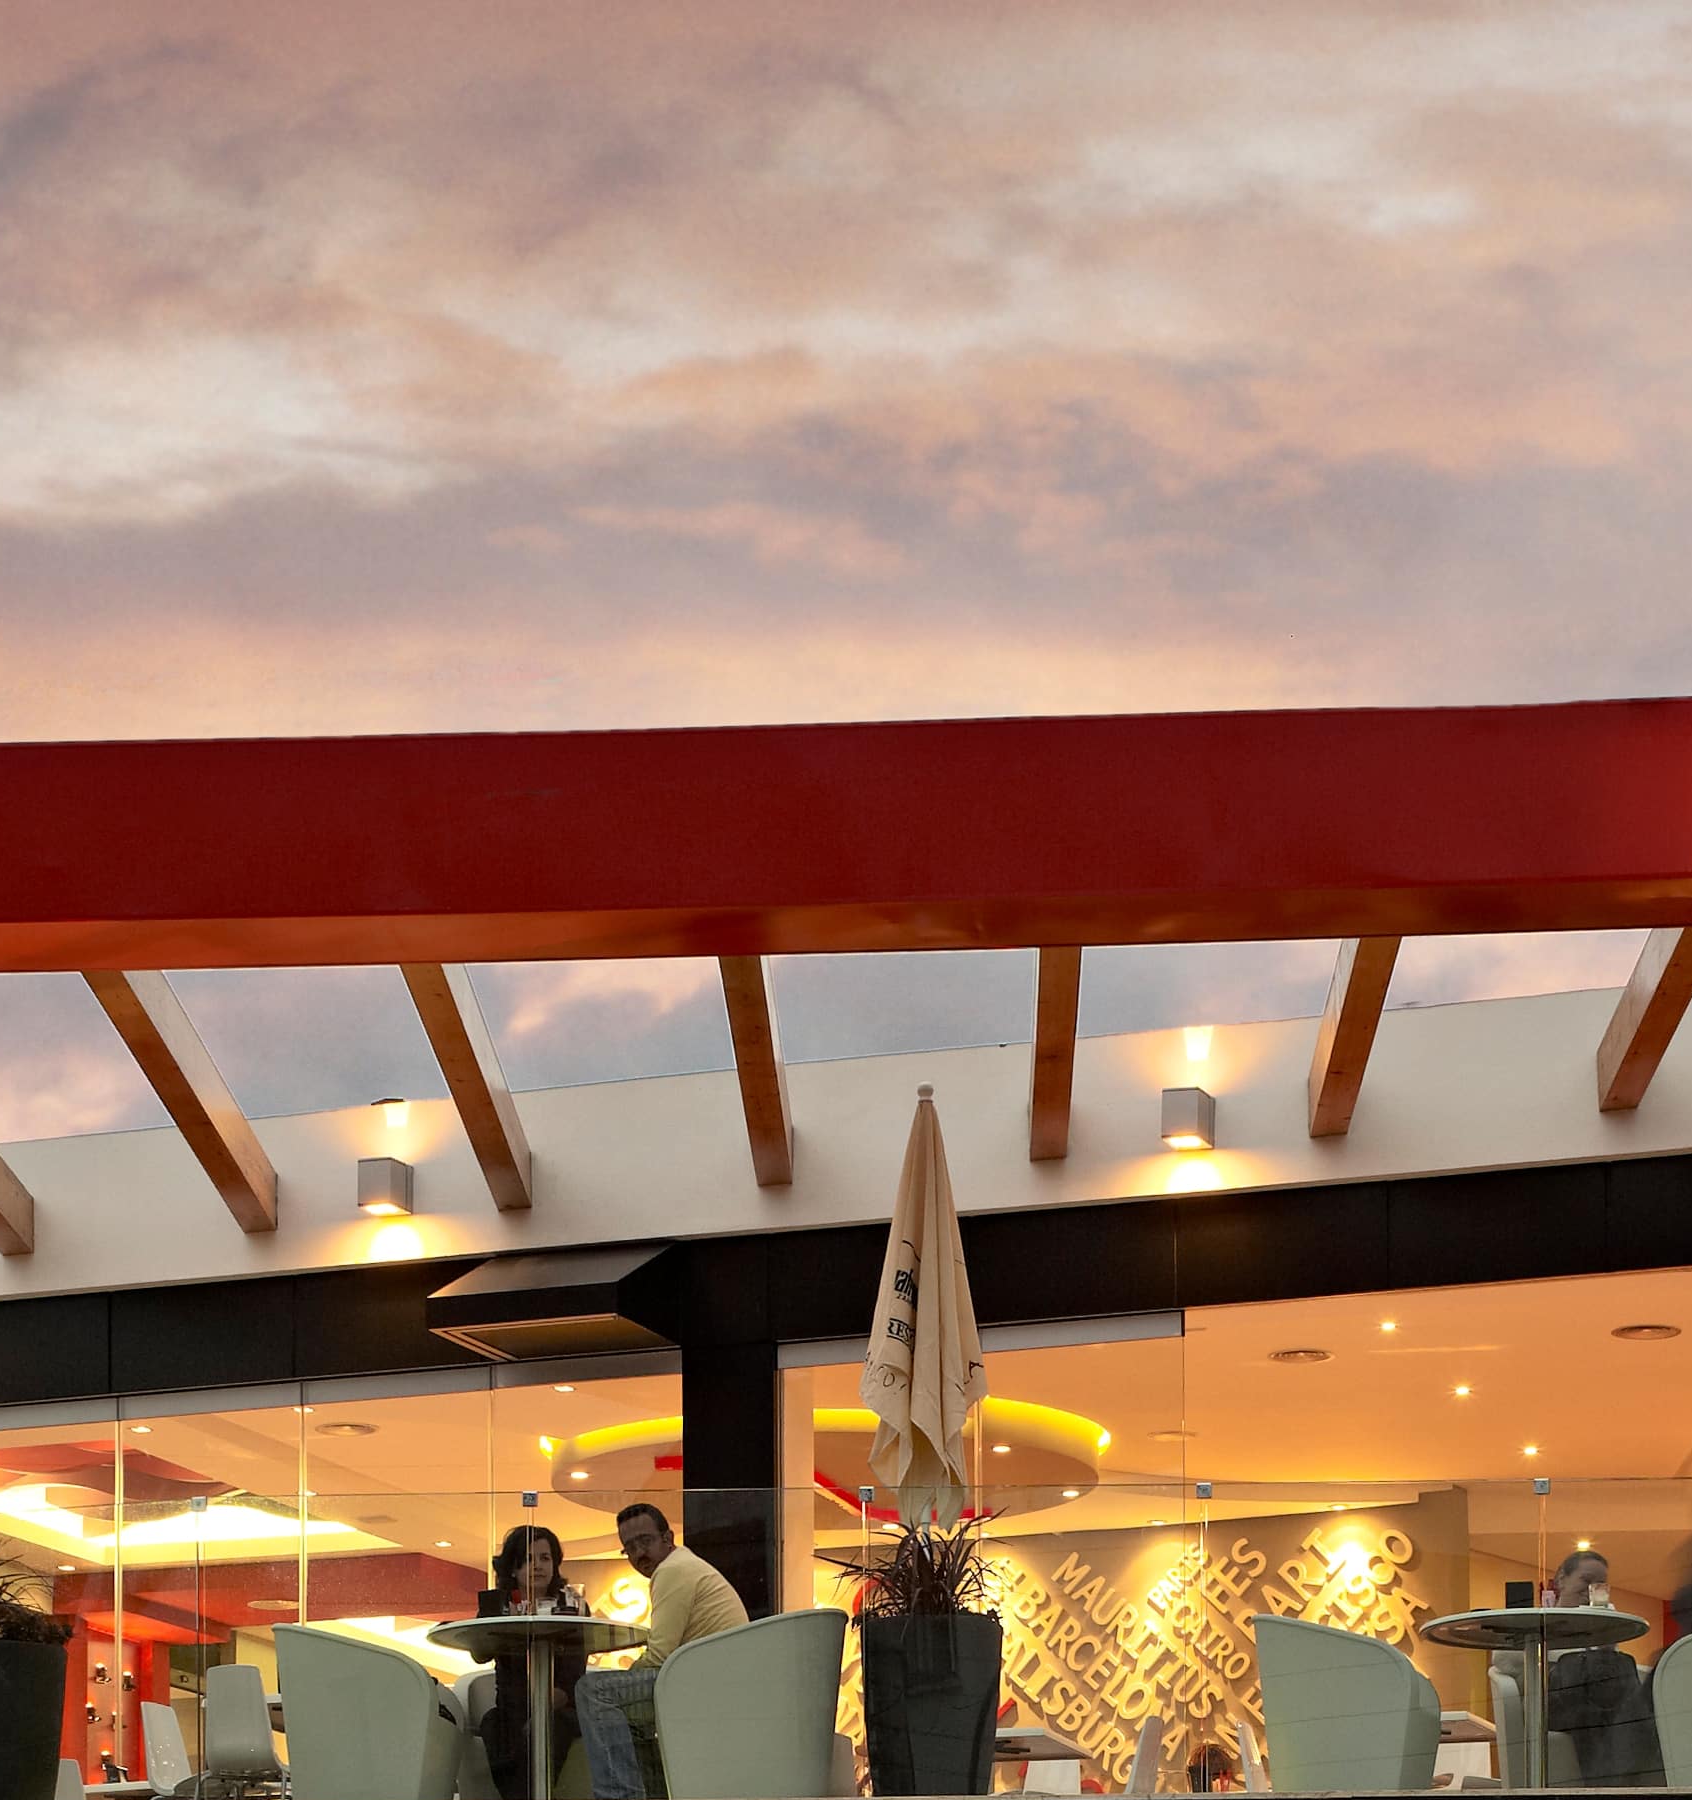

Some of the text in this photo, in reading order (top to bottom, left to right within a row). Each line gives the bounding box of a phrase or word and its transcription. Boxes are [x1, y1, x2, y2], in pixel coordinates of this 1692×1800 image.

[1013, 1583, 1188, 1760] BARCELONA
[1051, 1552, 1223, 1719] MAURITIUS
[1170, 1600, 1251, 1680] CAIRO
